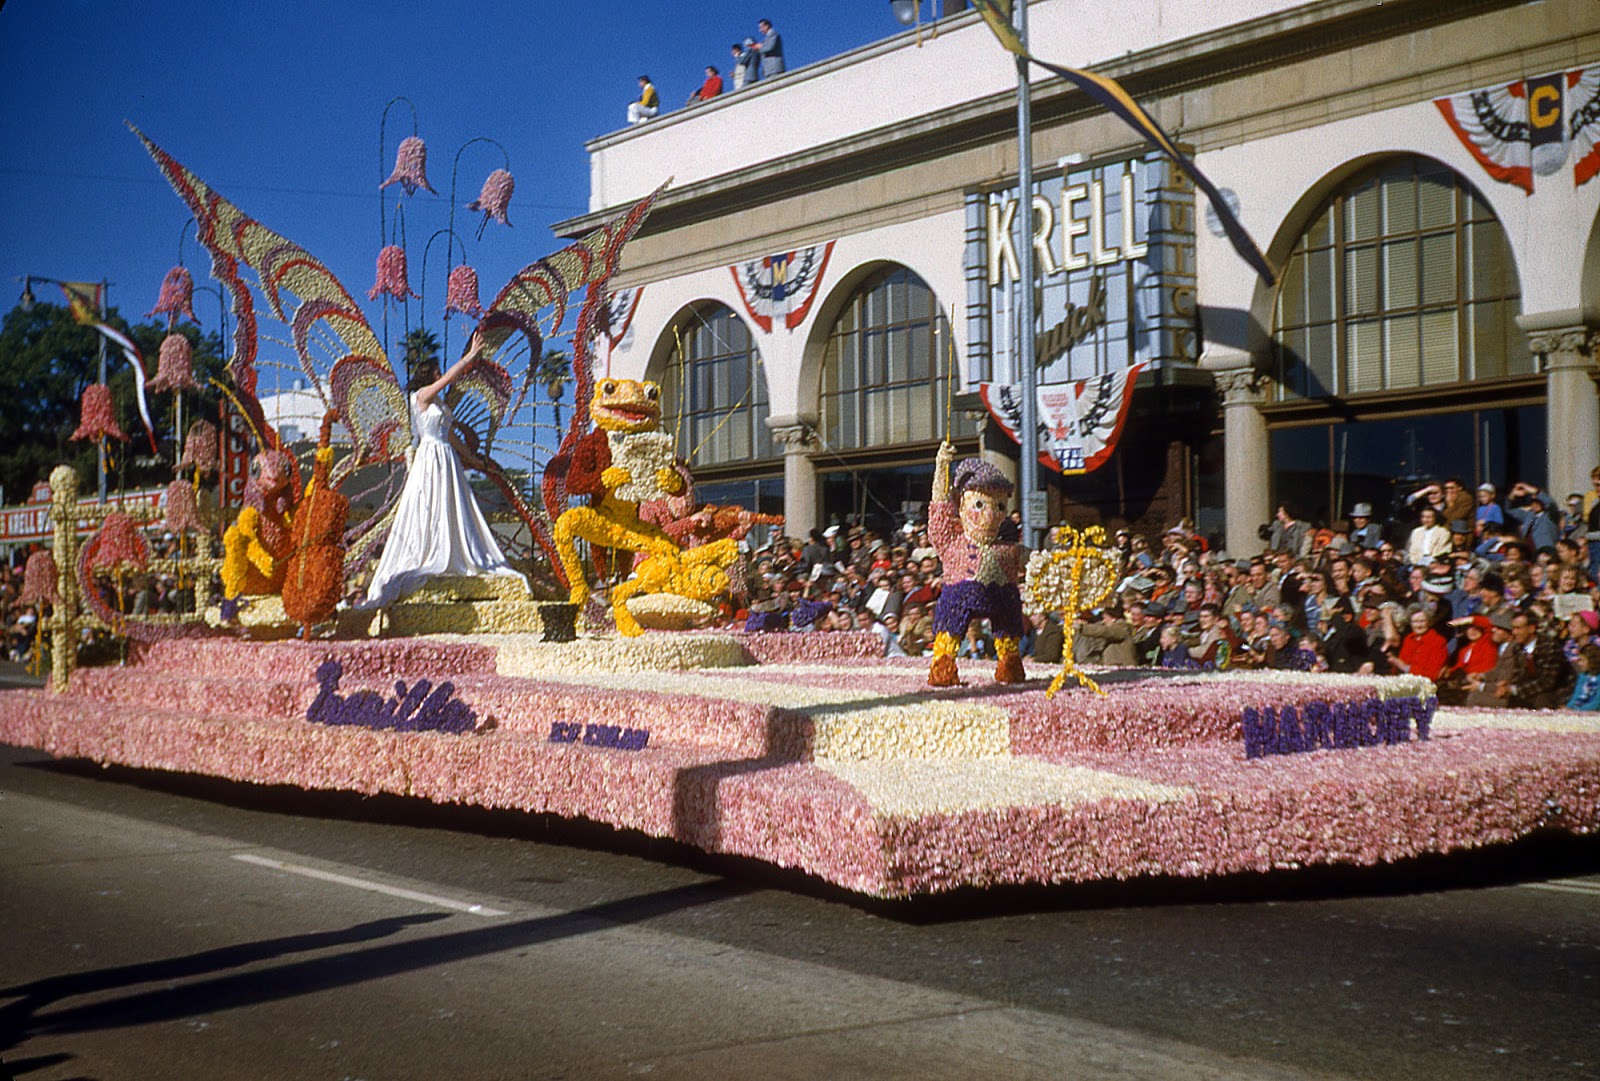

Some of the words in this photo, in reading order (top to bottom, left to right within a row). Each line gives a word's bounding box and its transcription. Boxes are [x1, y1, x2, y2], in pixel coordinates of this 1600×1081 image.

[1530, 84, 1561, 129] C
[986, 173, 1149, 286] KRELL
[1167, 159, 1192, 358] BUICK
